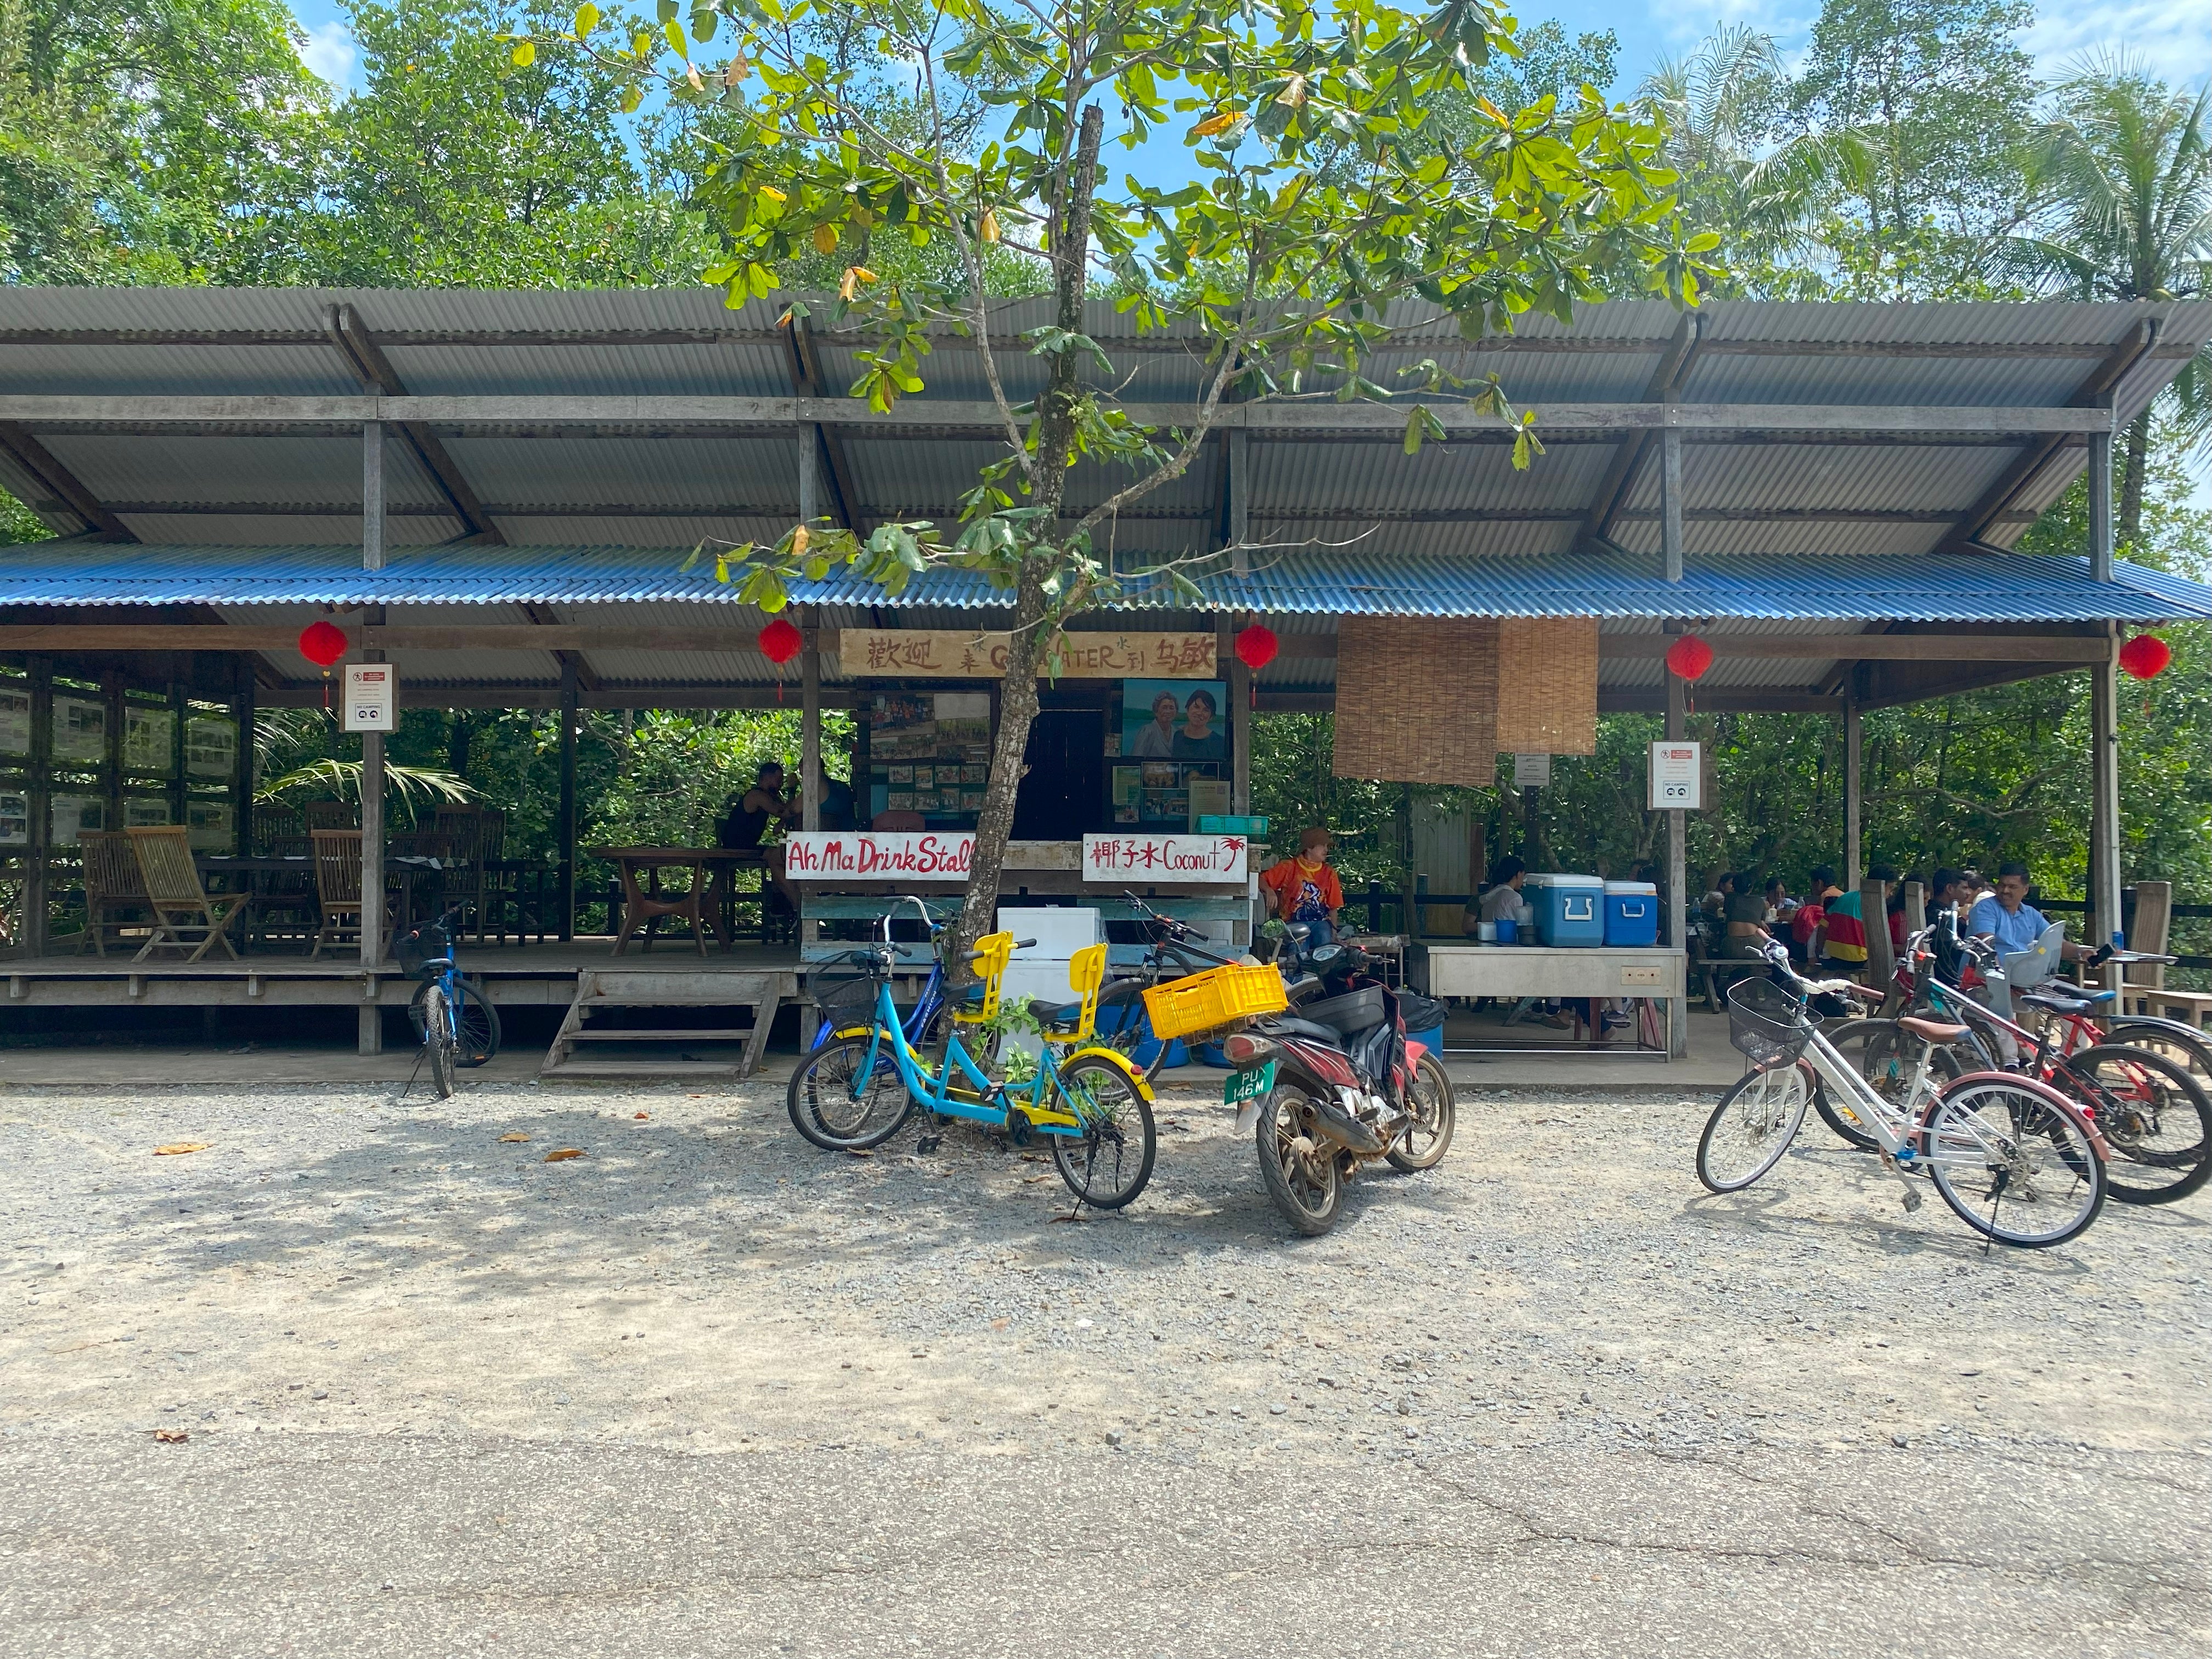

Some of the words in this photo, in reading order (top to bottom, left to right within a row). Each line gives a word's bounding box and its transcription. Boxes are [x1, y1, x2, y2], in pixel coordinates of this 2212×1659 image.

[867, 636, 942, 670] 歡迎
[1127, 651, 1145, 672] 到
[1150, 635, 1215, 673] 乌敏
[1116, 635, 1131, 650] 水
[788, 841, 819, 871] Ah
[821, 840, 855, 871] Ma
[858, 838, 917, 873] Drink
[1090, 839, 1163, 869] 椰子水
[1163, 839, 1221, 870] Coconut
[921, 990, 937, 1028] FASHION
[1242, 1069, 1259, 1085] PU
